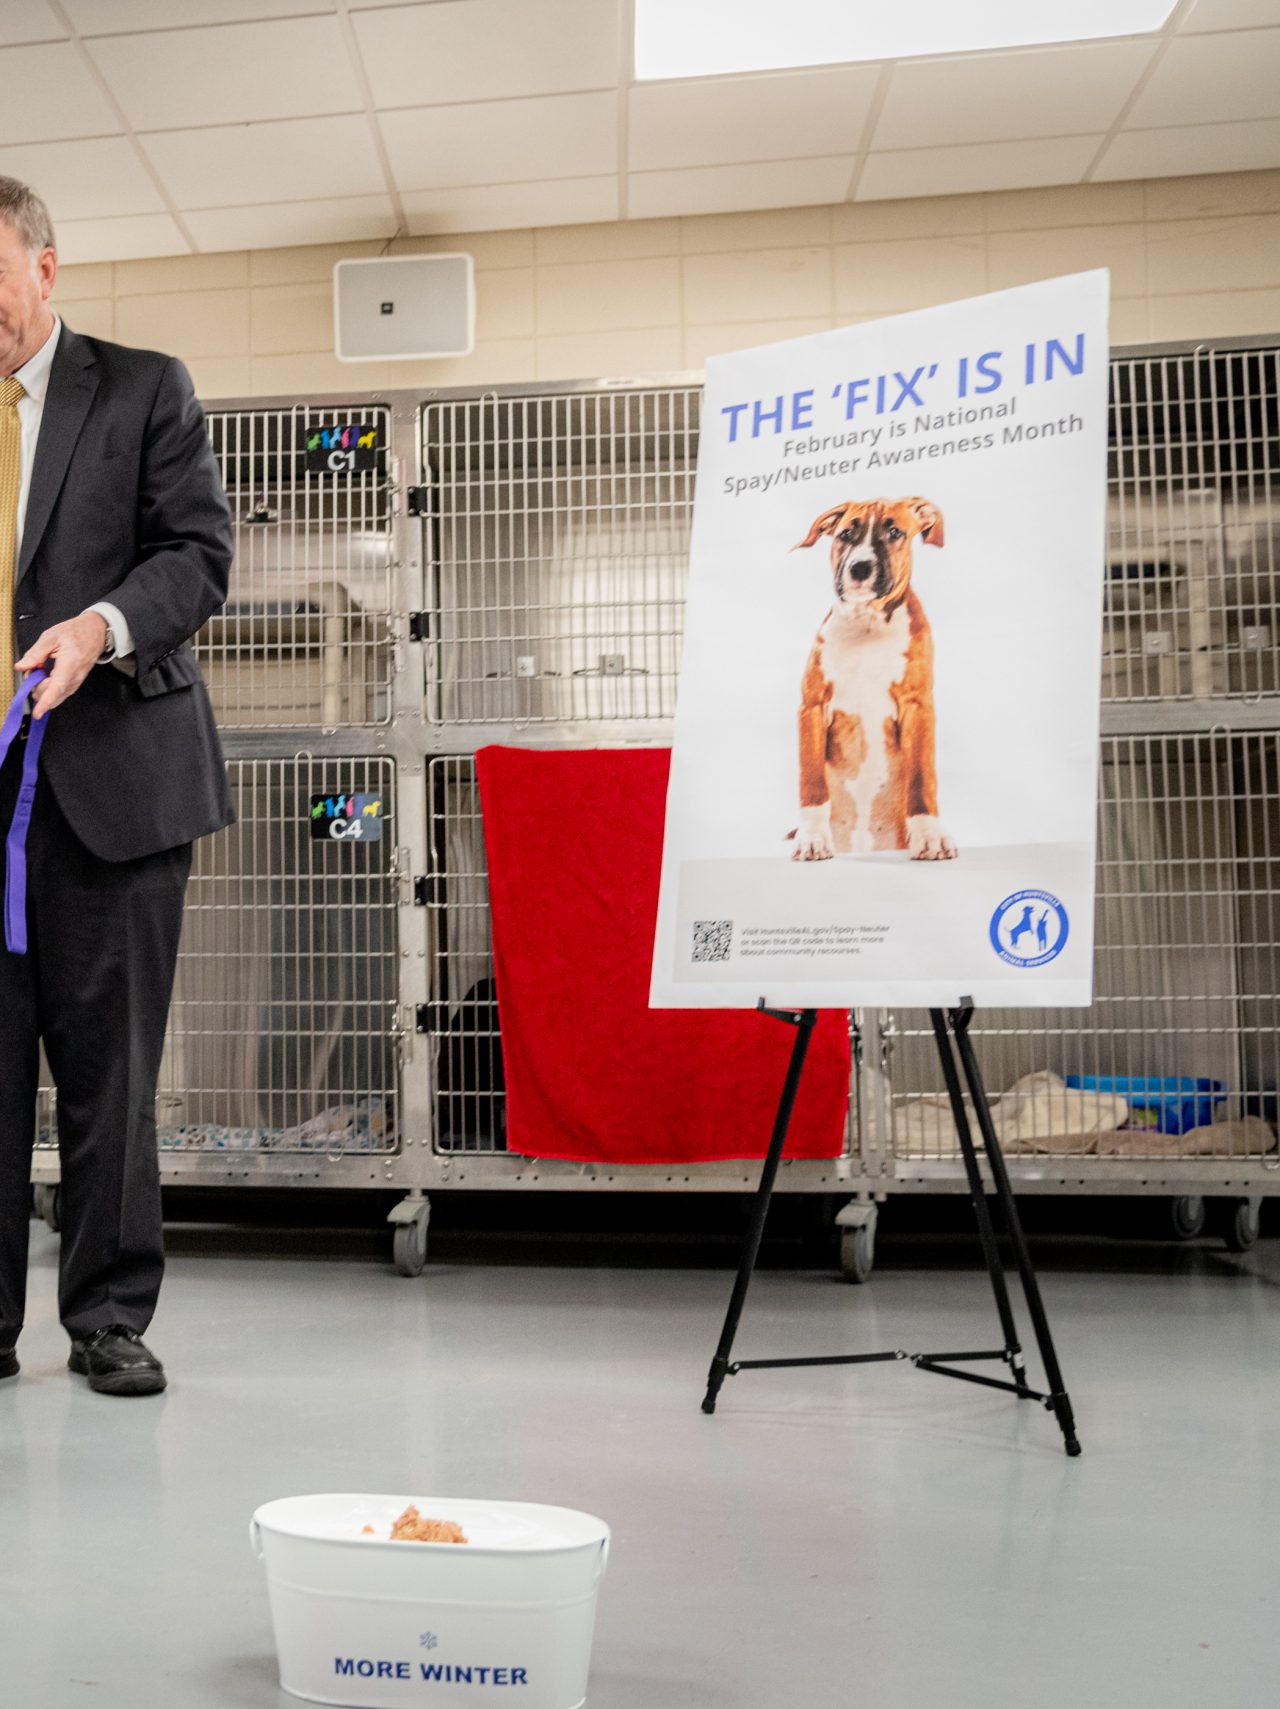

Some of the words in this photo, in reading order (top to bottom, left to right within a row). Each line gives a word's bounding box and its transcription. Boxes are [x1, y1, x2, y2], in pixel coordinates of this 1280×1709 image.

[722, 390, 812, 441] THE
[959, 352, 1002, 398] IS
[1026, 334, 1084, 385] IN
[784, 426, 882, 457] February
[890, 421, 906, 438] is
[914, 397, 1016, 433] National
[327, 450, 356, 471] C1
[724, 454, 861, 496] Spay/Neuter
[867, 434, 994, 469] Awareness
[1003, 413, 1084, 445] Month
[329, 818, 364, 839] C4
[334, 1657, 412, 1680] MORE
[419, 1662, 529, 1686] WINTER
